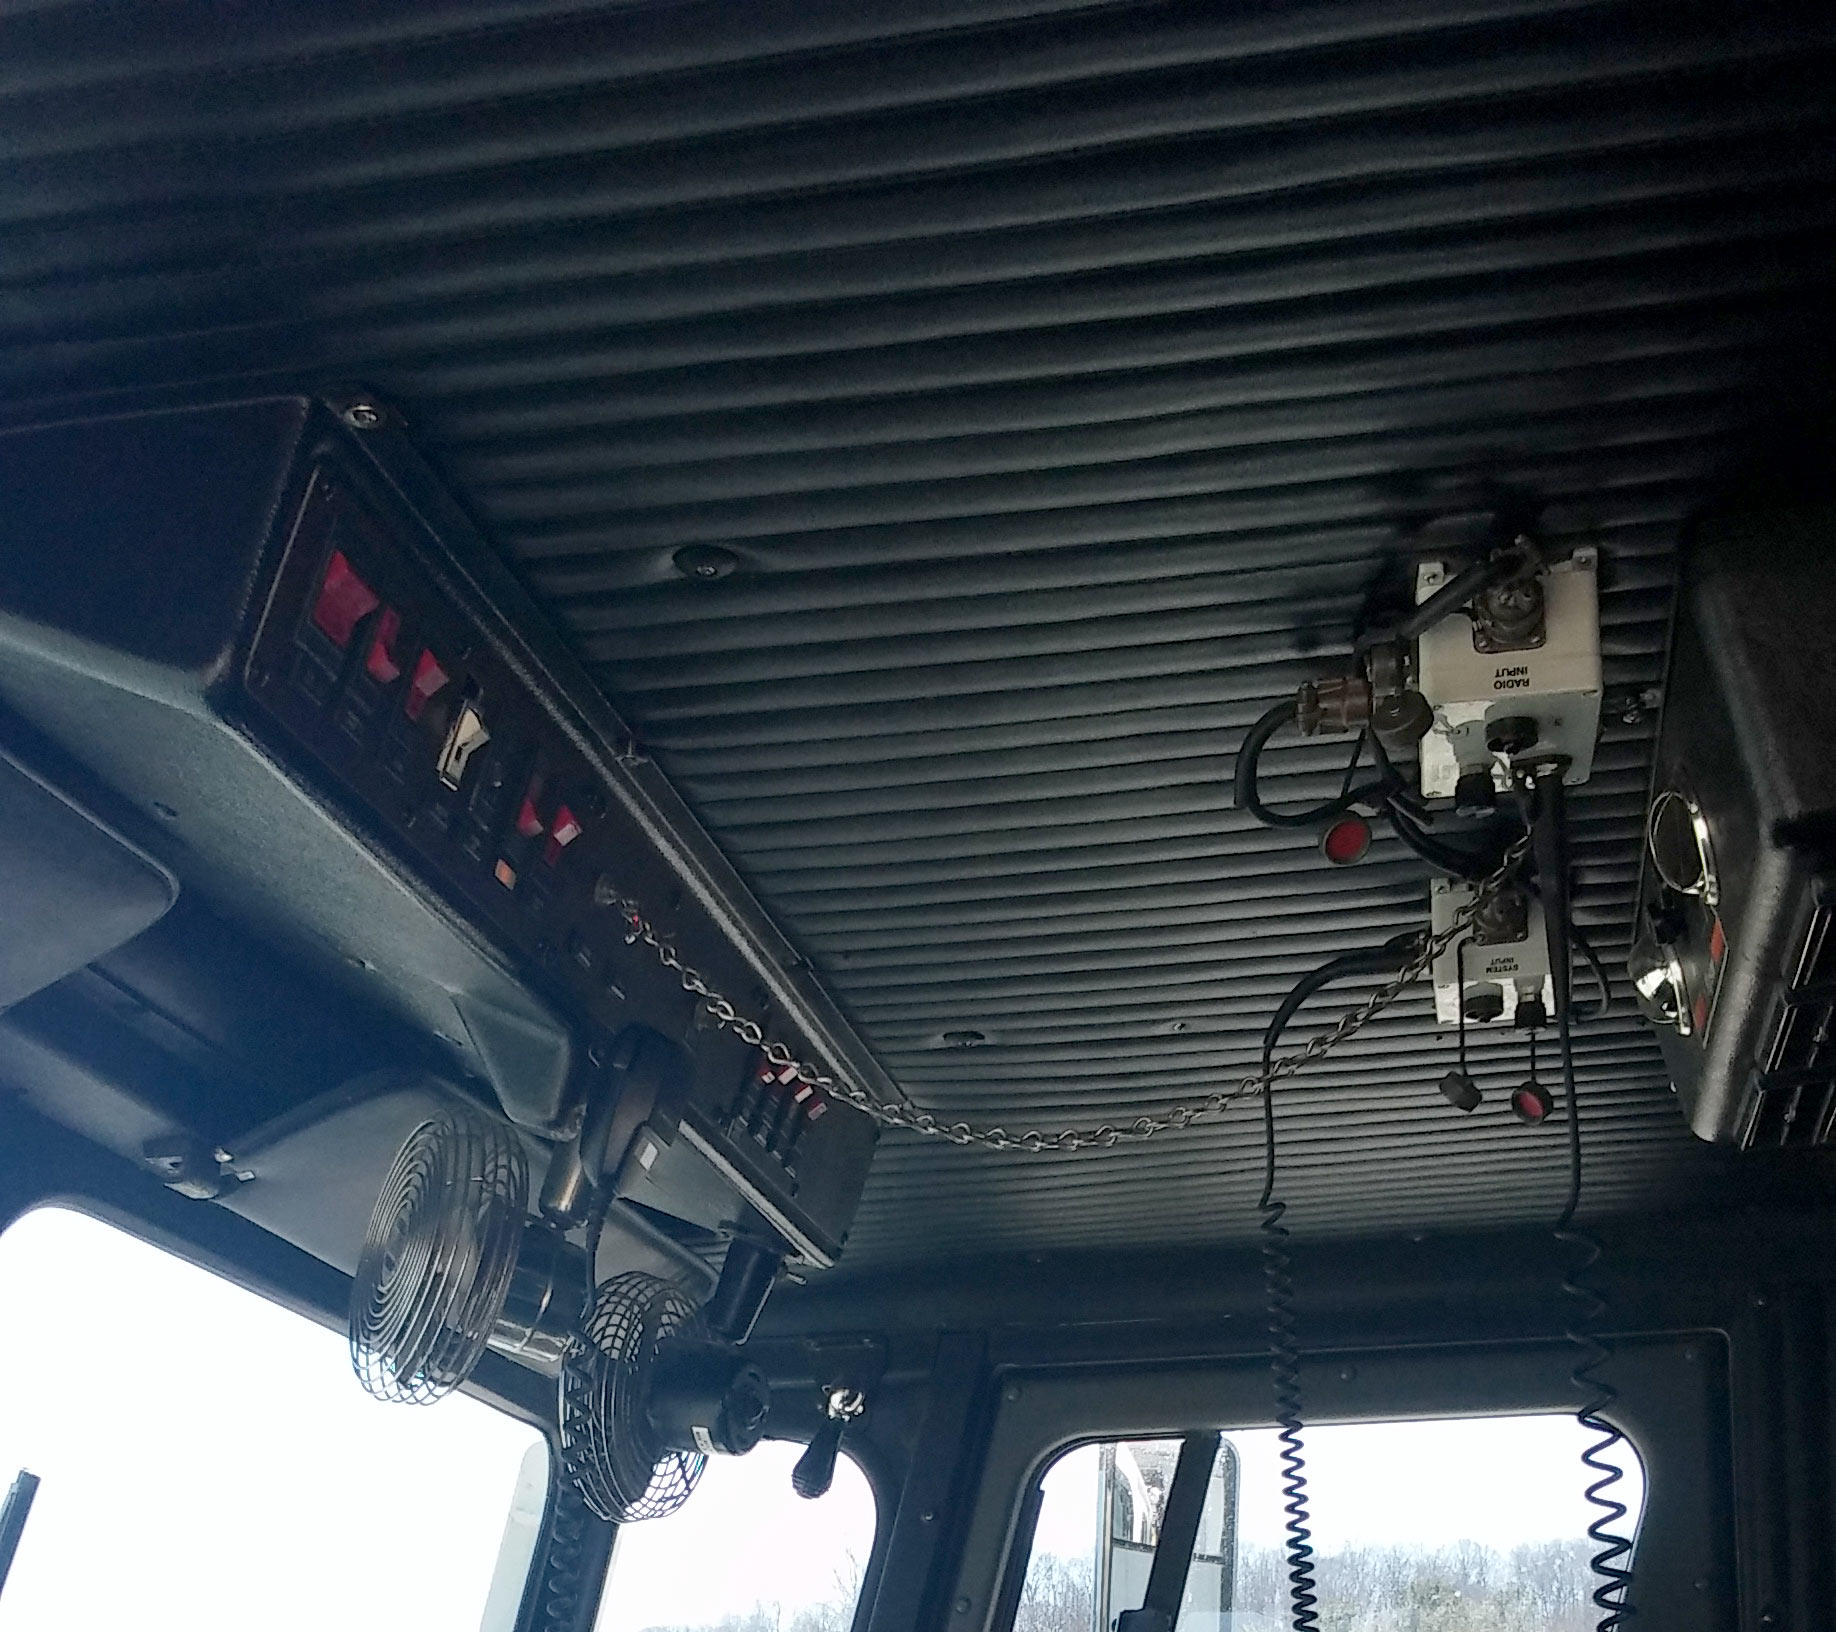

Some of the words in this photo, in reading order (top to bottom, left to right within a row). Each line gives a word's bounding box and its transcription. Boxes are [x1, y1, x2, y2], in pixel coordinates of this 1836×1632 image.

[1494, 666, 1528, 678] INPUT
[1493, 678, 1530, 690] RADIO
[1490, 957, 1514, 966] INPUT
[1485, 963, 1519, 974] SYSTEM
